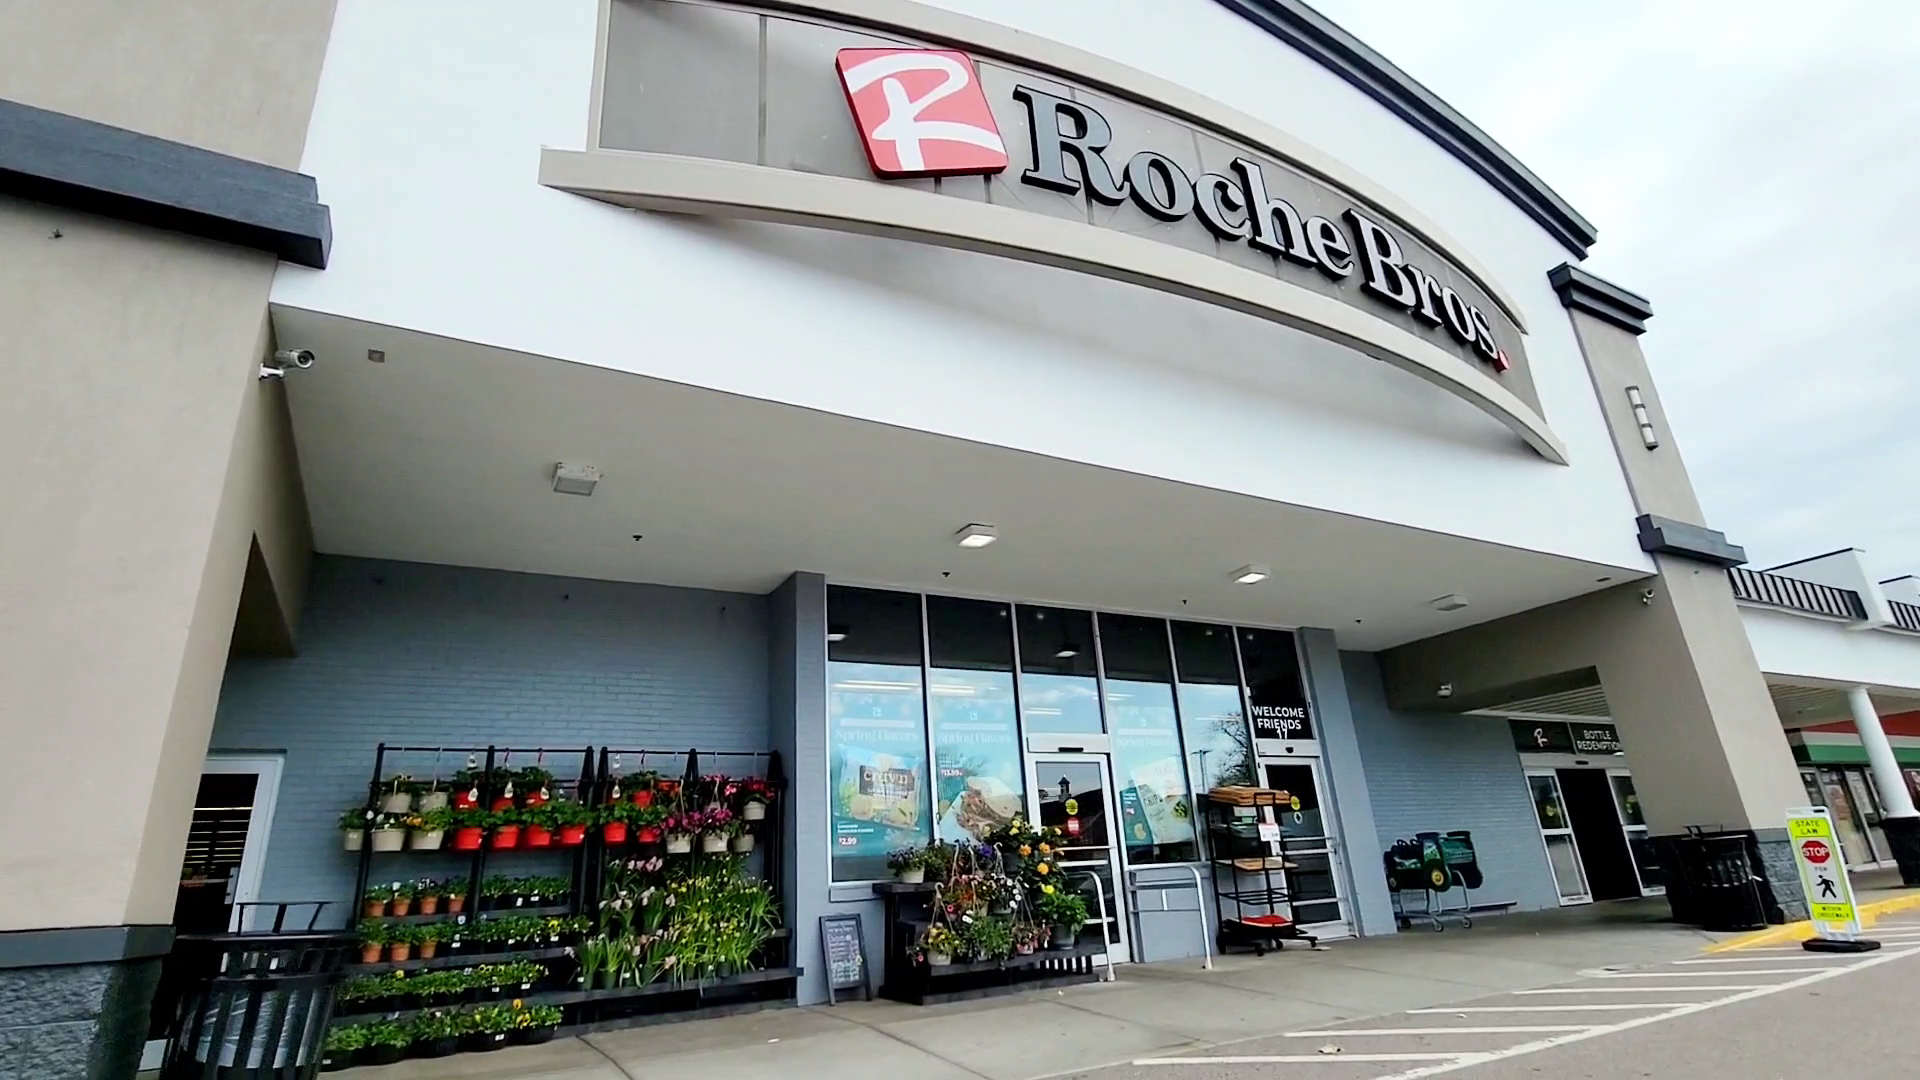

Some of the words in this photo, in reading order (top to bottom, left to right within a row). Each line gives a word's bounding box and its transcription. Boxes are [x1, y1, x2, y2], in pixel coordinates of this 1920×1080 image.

[1013, 84, 1356, 281] Roche
[1343, 208, 1511, 373] Bros.
[1252, 706, 1305, 718] WELCOME
[1257, 719, 1302, 730] FRIENDS
[1583, 730, 1612, 740] BOTTLE
[1795, 820, 1820, 828] STATE
[1802, 847, 1828, 857] STOP
